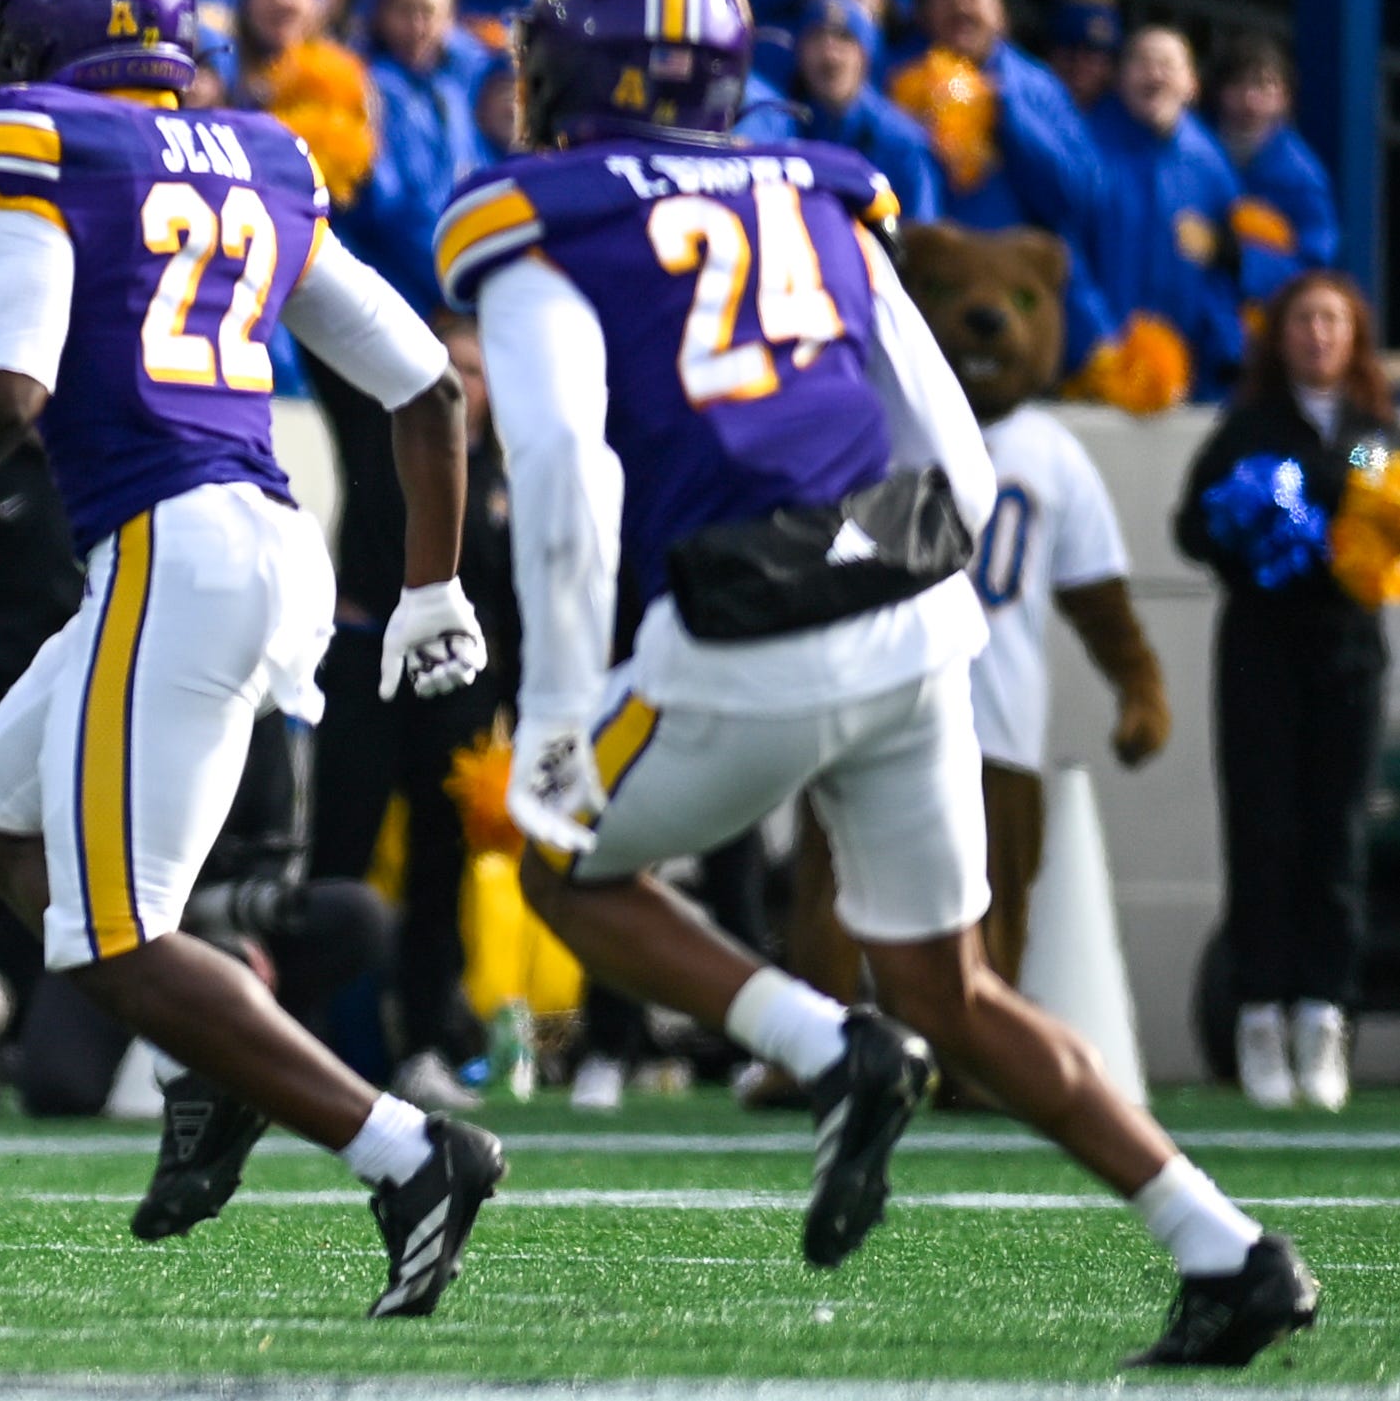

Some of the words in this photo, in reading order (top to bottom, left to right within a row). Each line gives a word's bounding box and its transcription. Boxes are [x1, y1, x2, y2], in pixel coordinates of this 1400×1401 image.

[107, 0, 139, 37] A
[613, 68, 645, 109] A
[155, 116, 252, 181] JEAN
[141, 183, 277, 392] 22
[645, 181, 846, 412] 24
